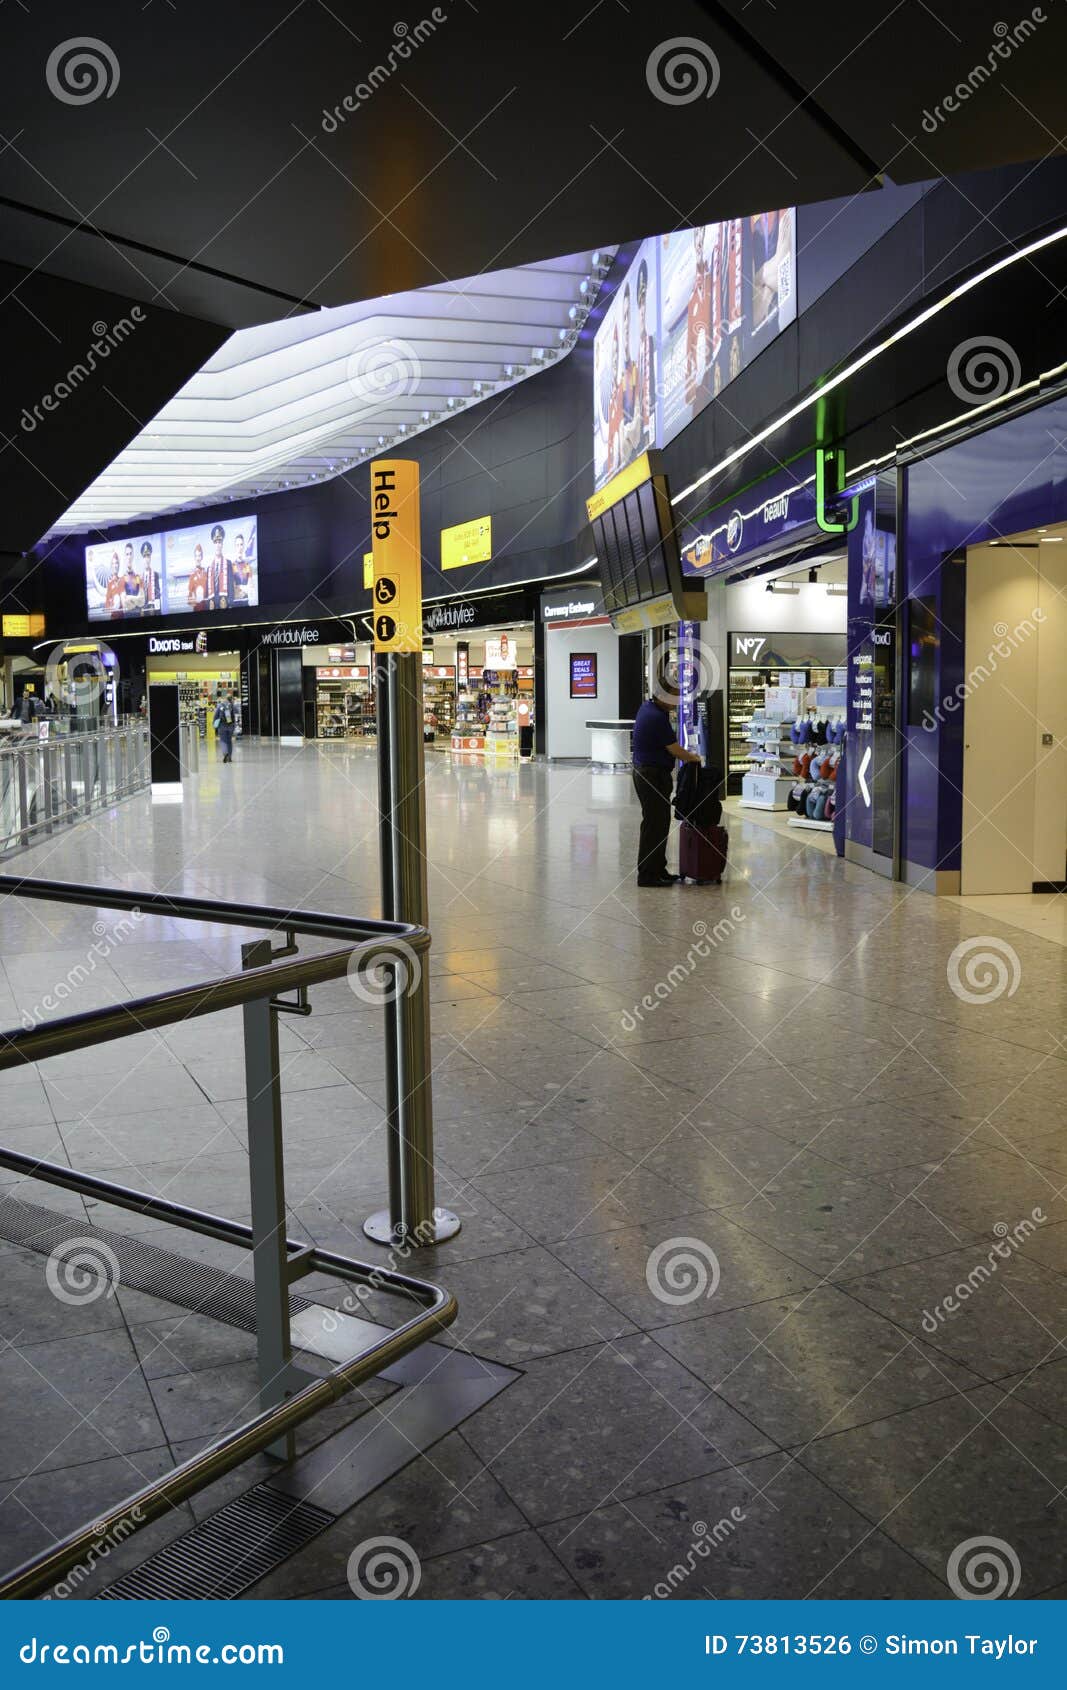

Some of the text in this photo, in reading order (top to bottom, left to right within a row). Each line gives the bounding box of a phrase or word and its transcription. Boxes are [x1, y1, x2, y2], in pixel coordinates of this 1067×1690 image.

[373, 470, 398, 540] Help
[764, 496, 789, 524] beauty
[150, 637, 181, 652] Dixons
